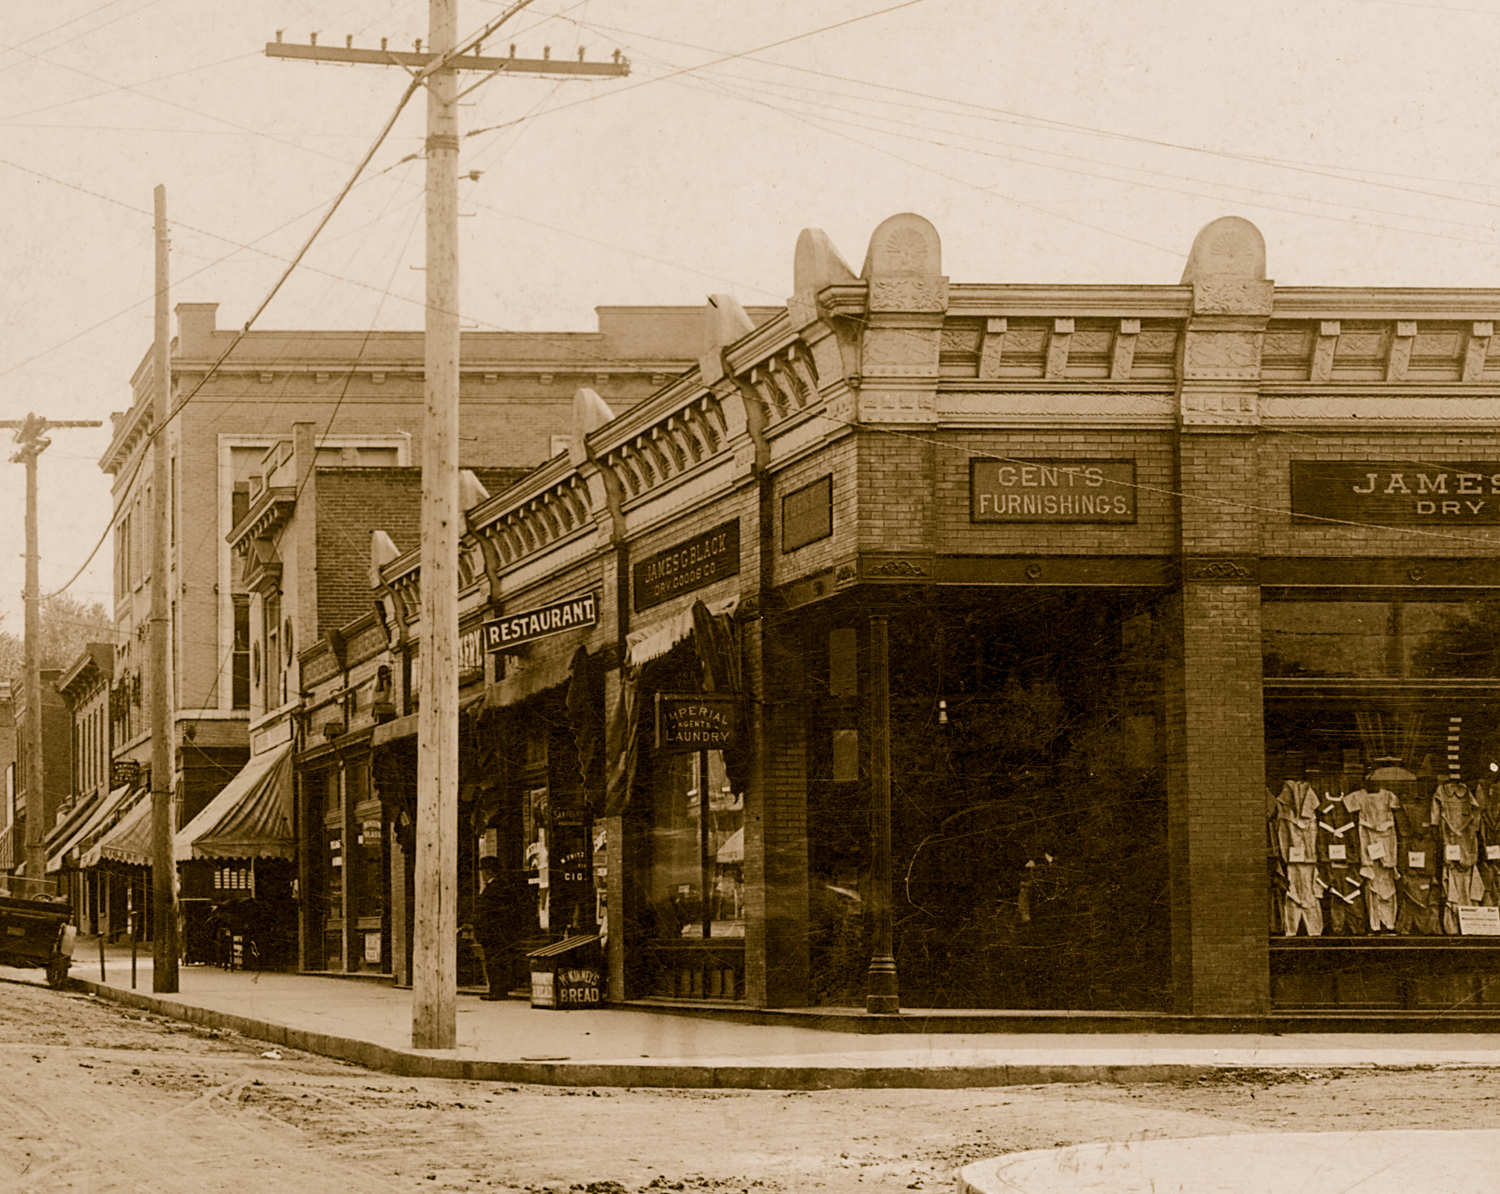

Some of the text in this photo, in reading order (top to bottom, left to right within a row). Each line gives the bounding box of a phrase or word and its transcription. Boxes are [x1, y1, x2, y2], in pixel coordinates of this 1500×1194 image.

[998, 465, 1103, 487] GENT'S
[1417, 501, 1486, 515] DRY
[645, 553, 680, 584] JAMES
[690, 532, 727, 565] BLACK
[654, 580, 671, 596] DRY
[672, 567, 701, 589] GOODS
[663, 706, 728, 725] IMPERIAL
[678, 720, 711, 729] AGENTS
[666, 730, 730, 742] LAUNDRY
[561, 987, 599, 1003] BREAD
